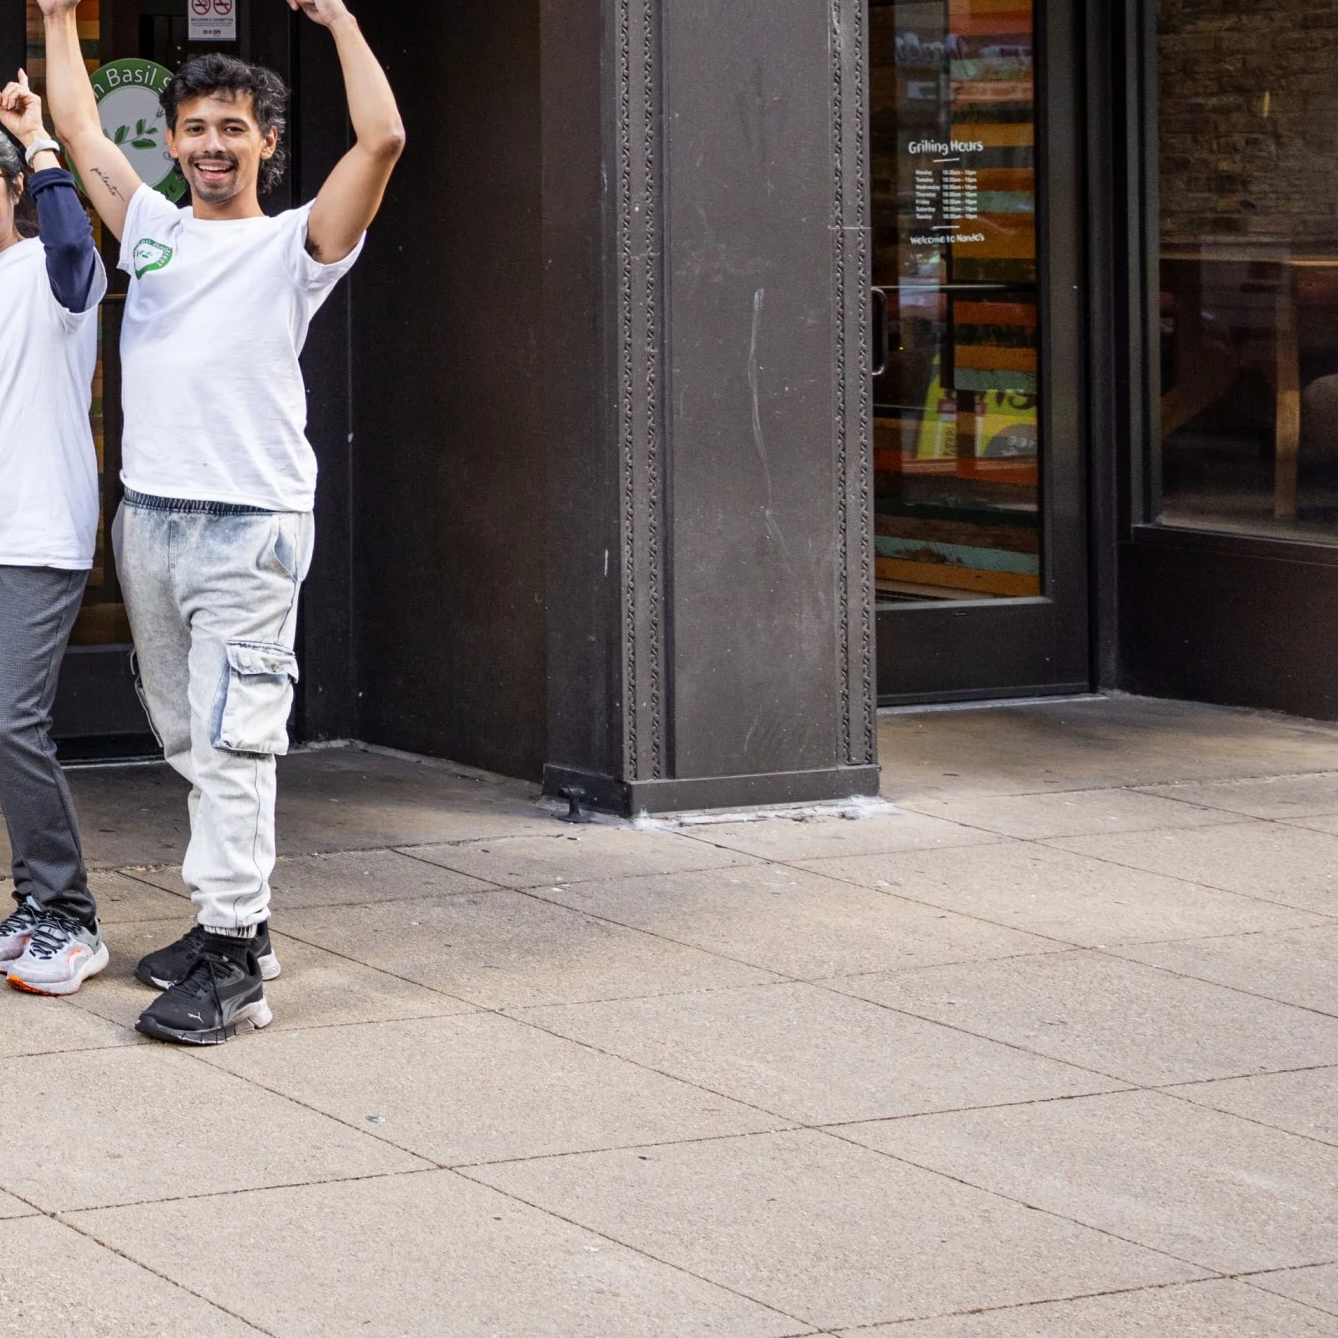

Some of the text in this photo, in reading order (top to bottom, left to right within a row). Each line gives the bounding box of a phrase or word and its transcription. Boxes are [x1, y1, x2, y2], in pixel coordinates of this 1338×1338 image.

[105, 65, 157, 87] Basil
[908, 139, 984, 156] Grilling Hours
